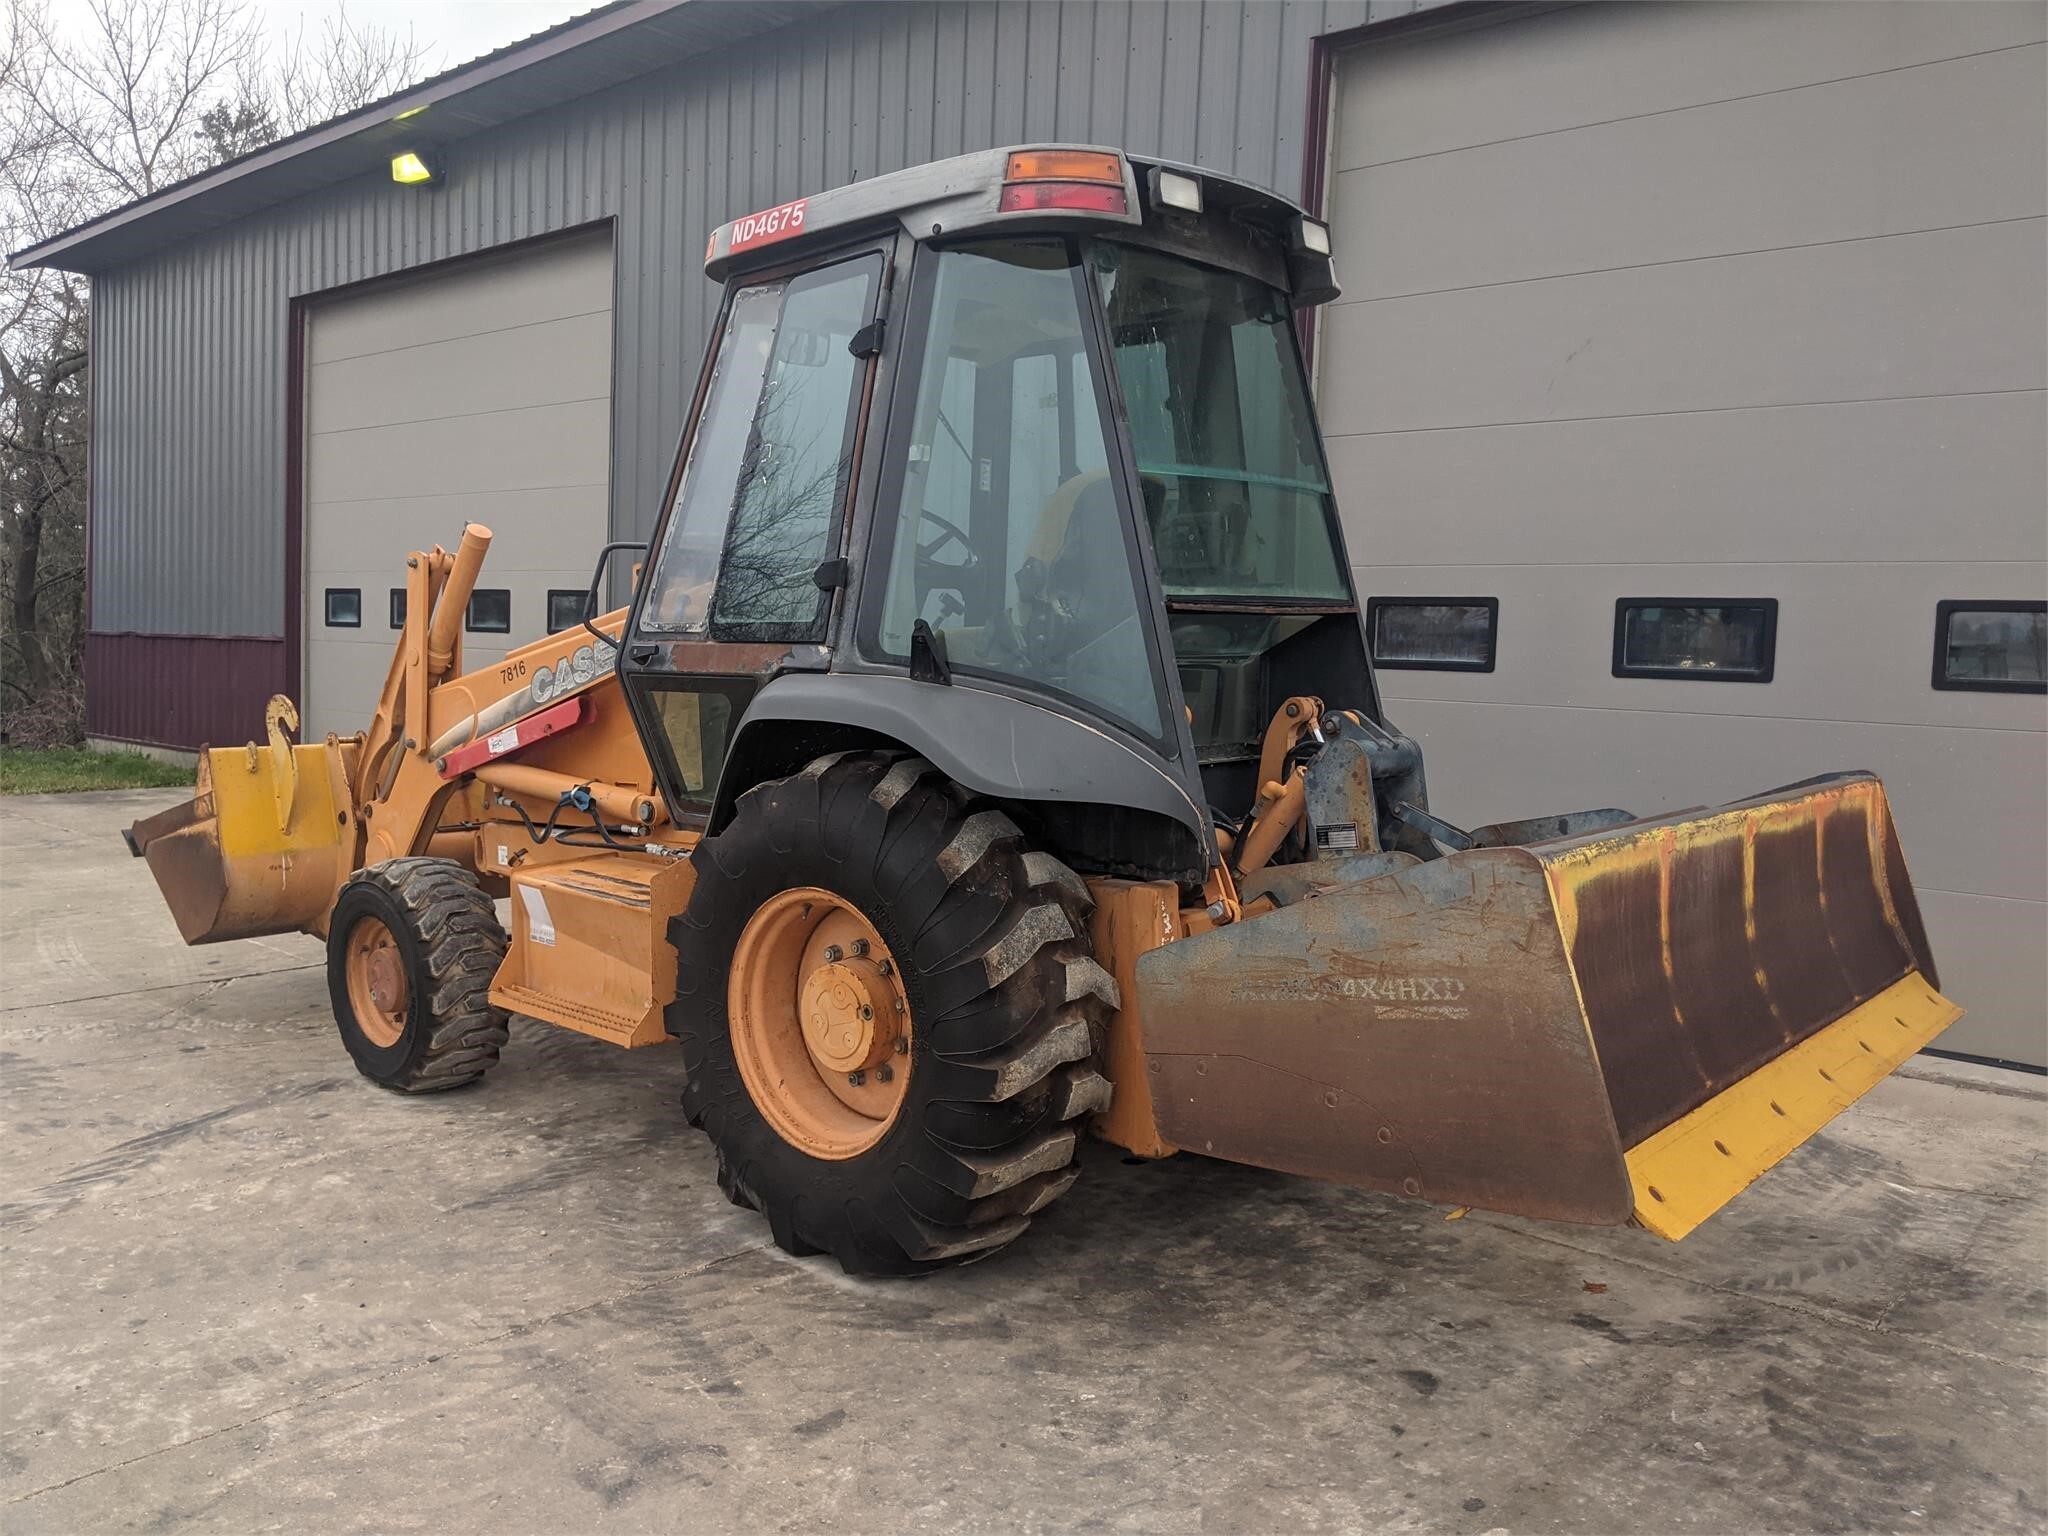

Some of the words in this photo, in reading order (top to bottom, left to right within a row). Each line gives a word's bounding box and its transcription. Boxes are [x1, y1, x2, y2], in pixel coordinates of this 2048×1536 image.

[731, 203, 805, 245] ND4G75
[500, 660, 526, 684] 7816
[530, 633, 618, 704] CASE
